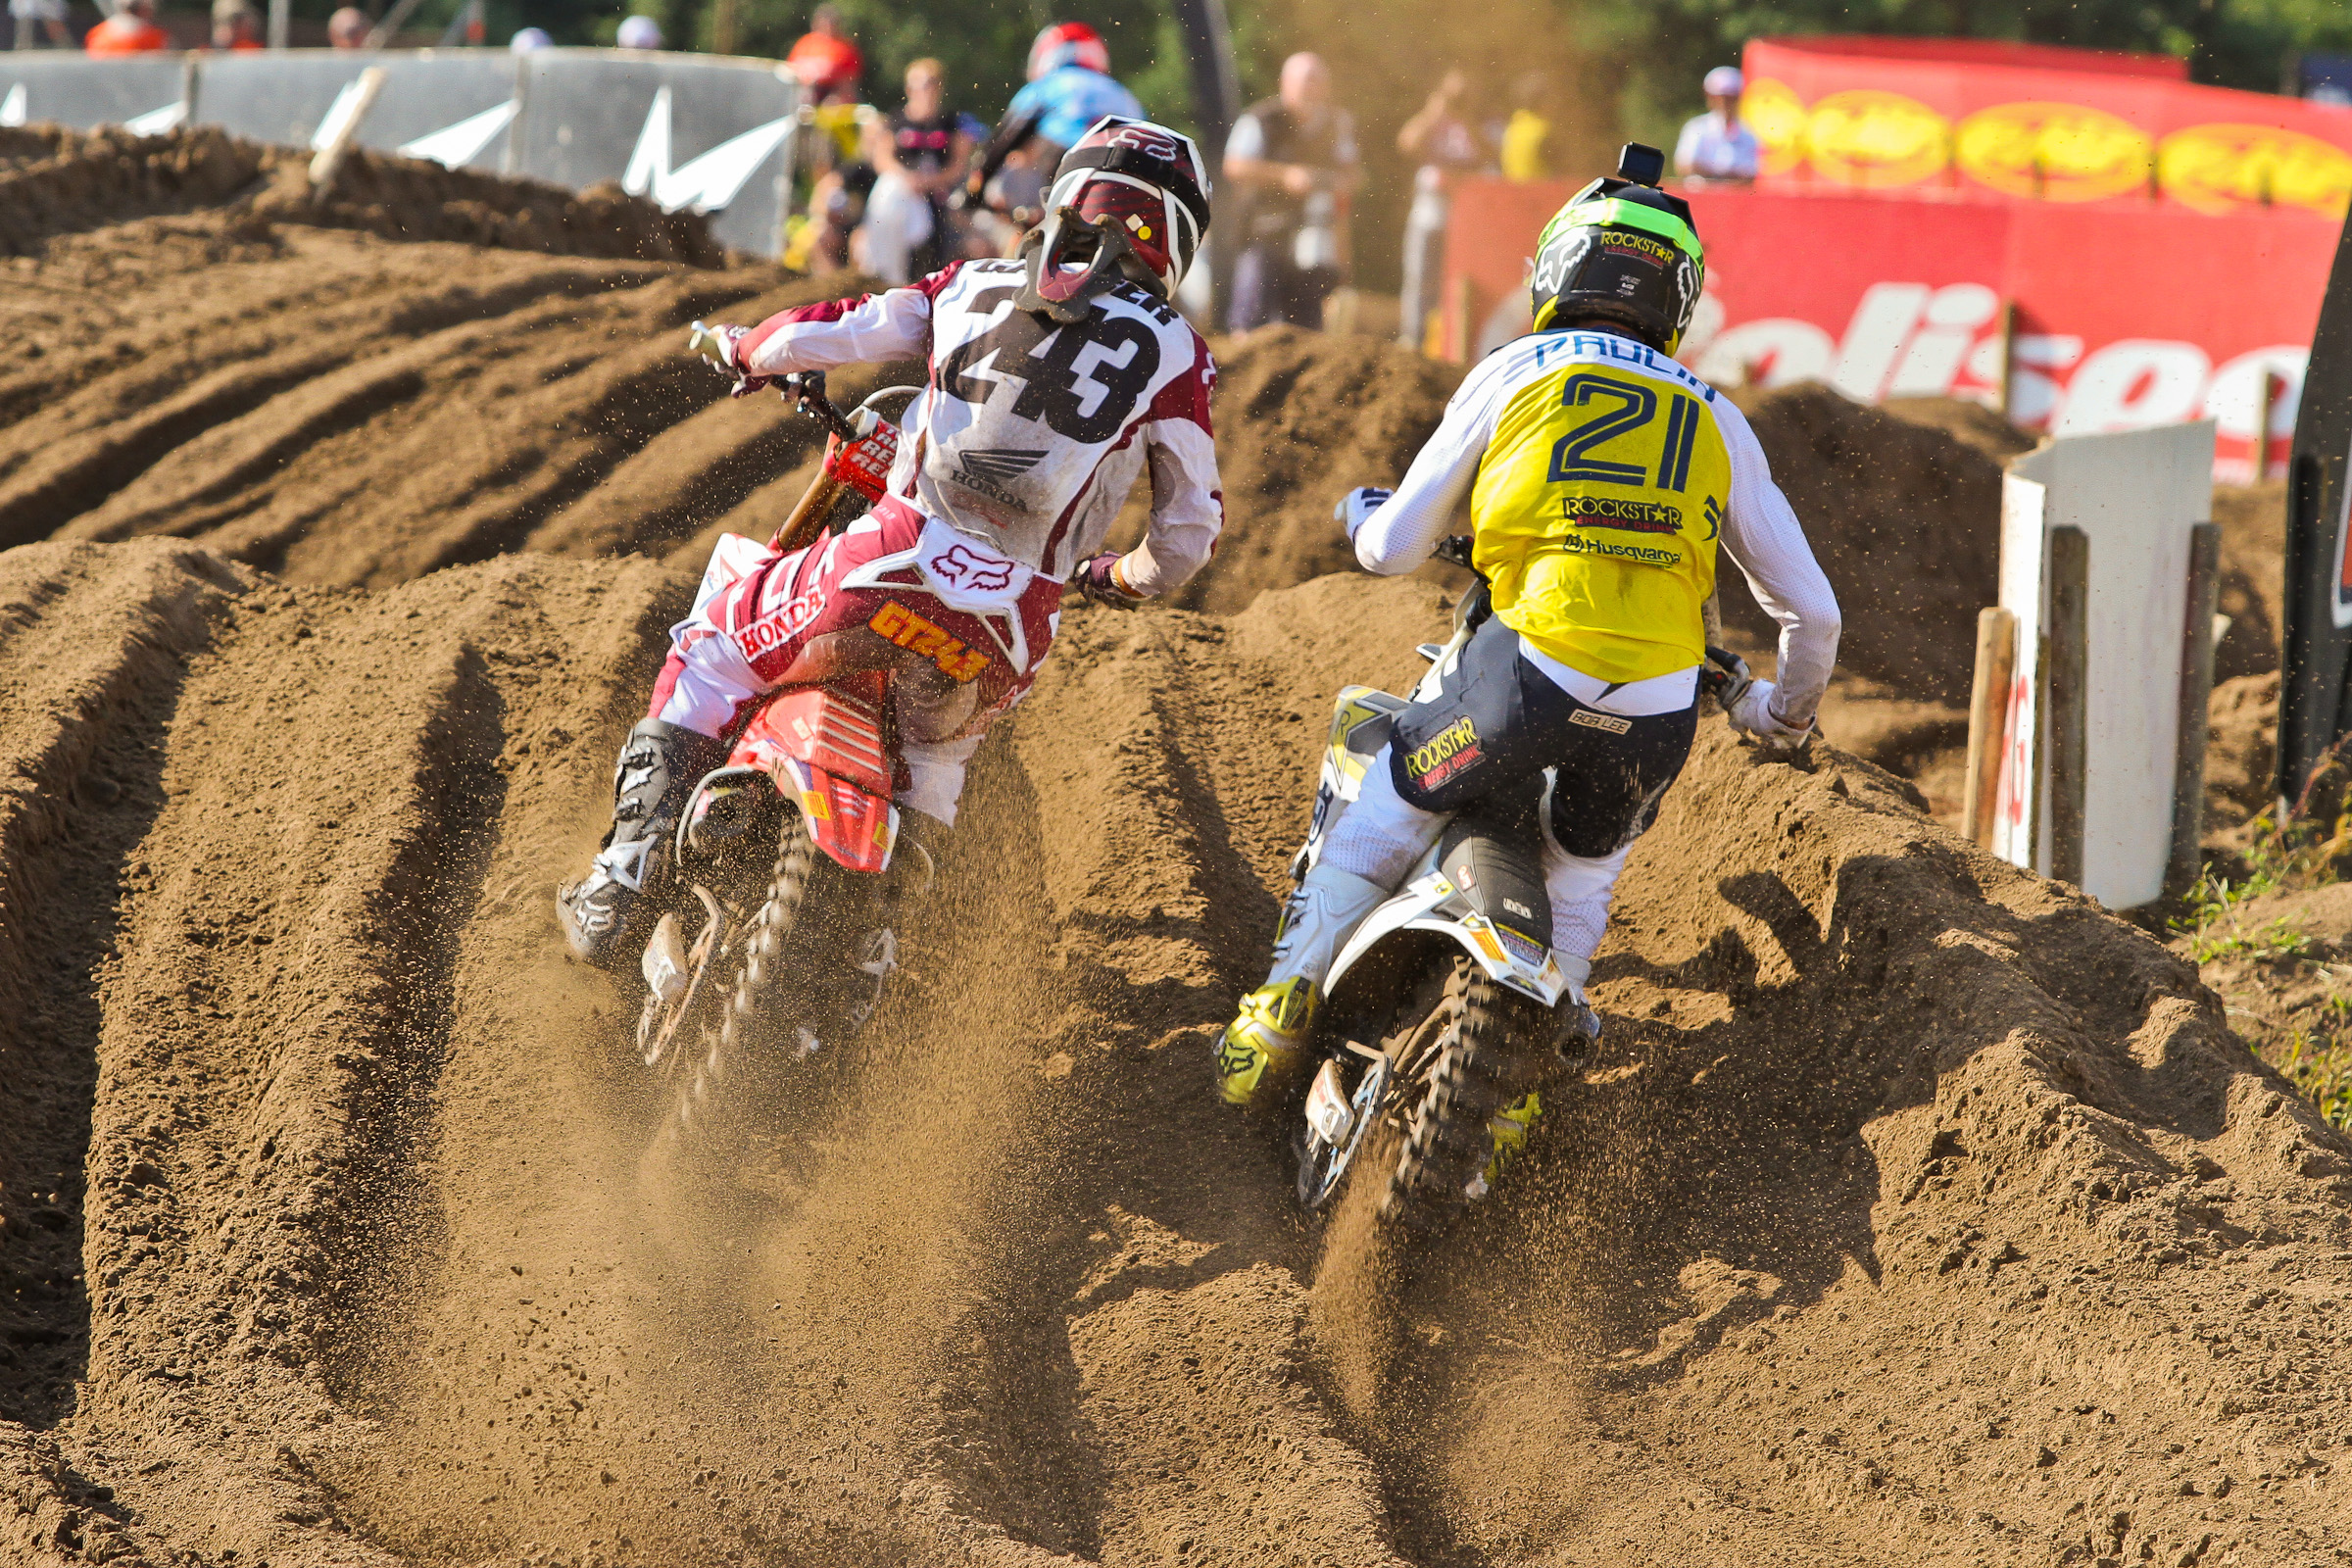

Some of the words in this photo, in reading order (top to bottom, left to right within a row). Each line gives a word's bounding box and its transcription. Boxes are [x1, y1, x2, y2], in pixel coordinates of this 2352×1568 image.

[938, 285, 1162, 445] 243
[1536, 334, 1716, 403] PAULIN
[1546, 372, 1700, 493] 21
[950, 468, 1029, 514] HONDA
[1576, 514, 1628, 529] ENERGY
[1633, 518, 1676, 534] DRINK
[1586, 539, 1682, 564] Husqvarna
[737, 589, 824, 659] HONDA
[1572, 711, 1601, 726] BOB
[1600, 717, 1628, 733] LEE
[1450, 745, 1481, 770] DRINK
